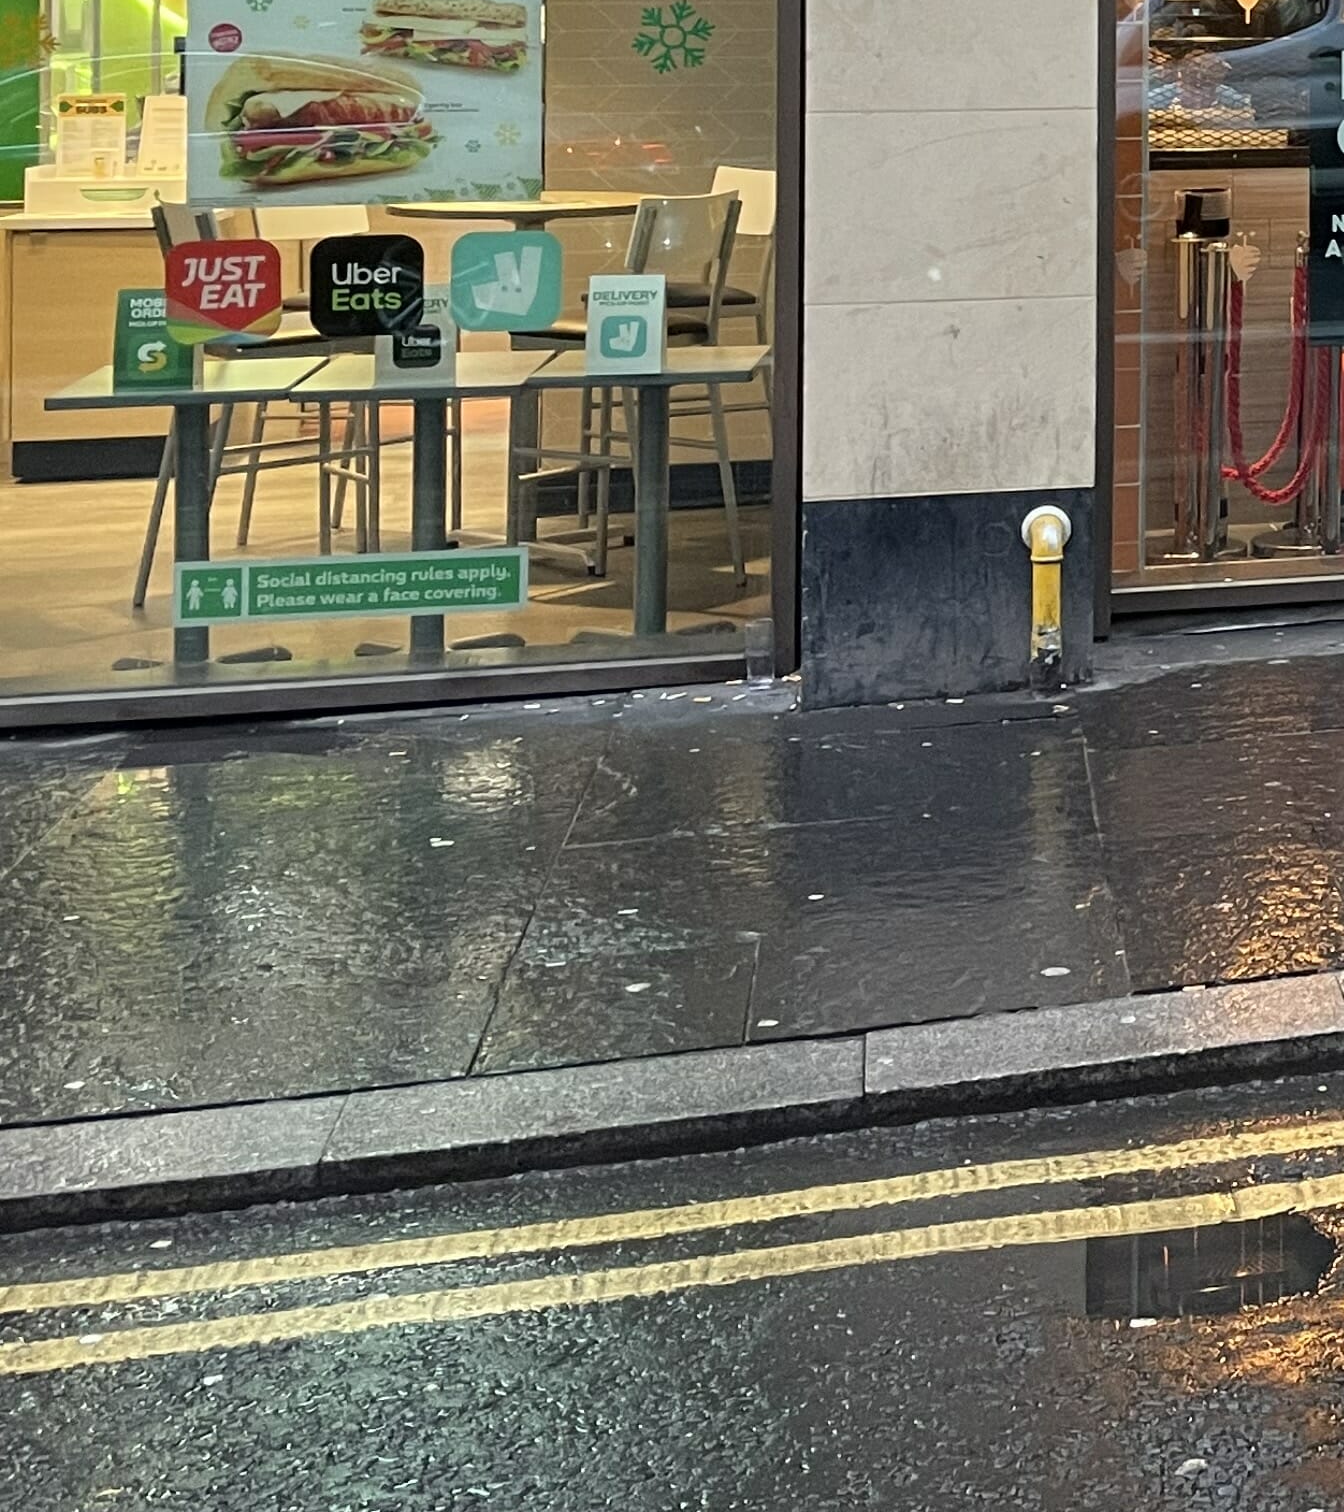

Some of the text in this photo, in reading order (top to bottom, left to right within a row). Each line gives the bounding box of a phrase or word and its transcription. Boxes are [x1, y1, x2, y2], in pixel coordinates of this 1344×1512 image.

[1324, 239, 1342, 258] A
[181, 256, 266, 287] JUST
[332, 262, 402, 285] Uber
[200, 283, 266, 310] EAT
[332, 289, 402, 311] Eats
[592, 290, 658, 301] DELIVERY
[256, 564, 512, 588] Social distancing rules apply.
[256, 592, 316, 608] Please
[320, 591, 363, 606] wear
[368, 592, 379, 603] a
[383, 587, 420, 602] face
